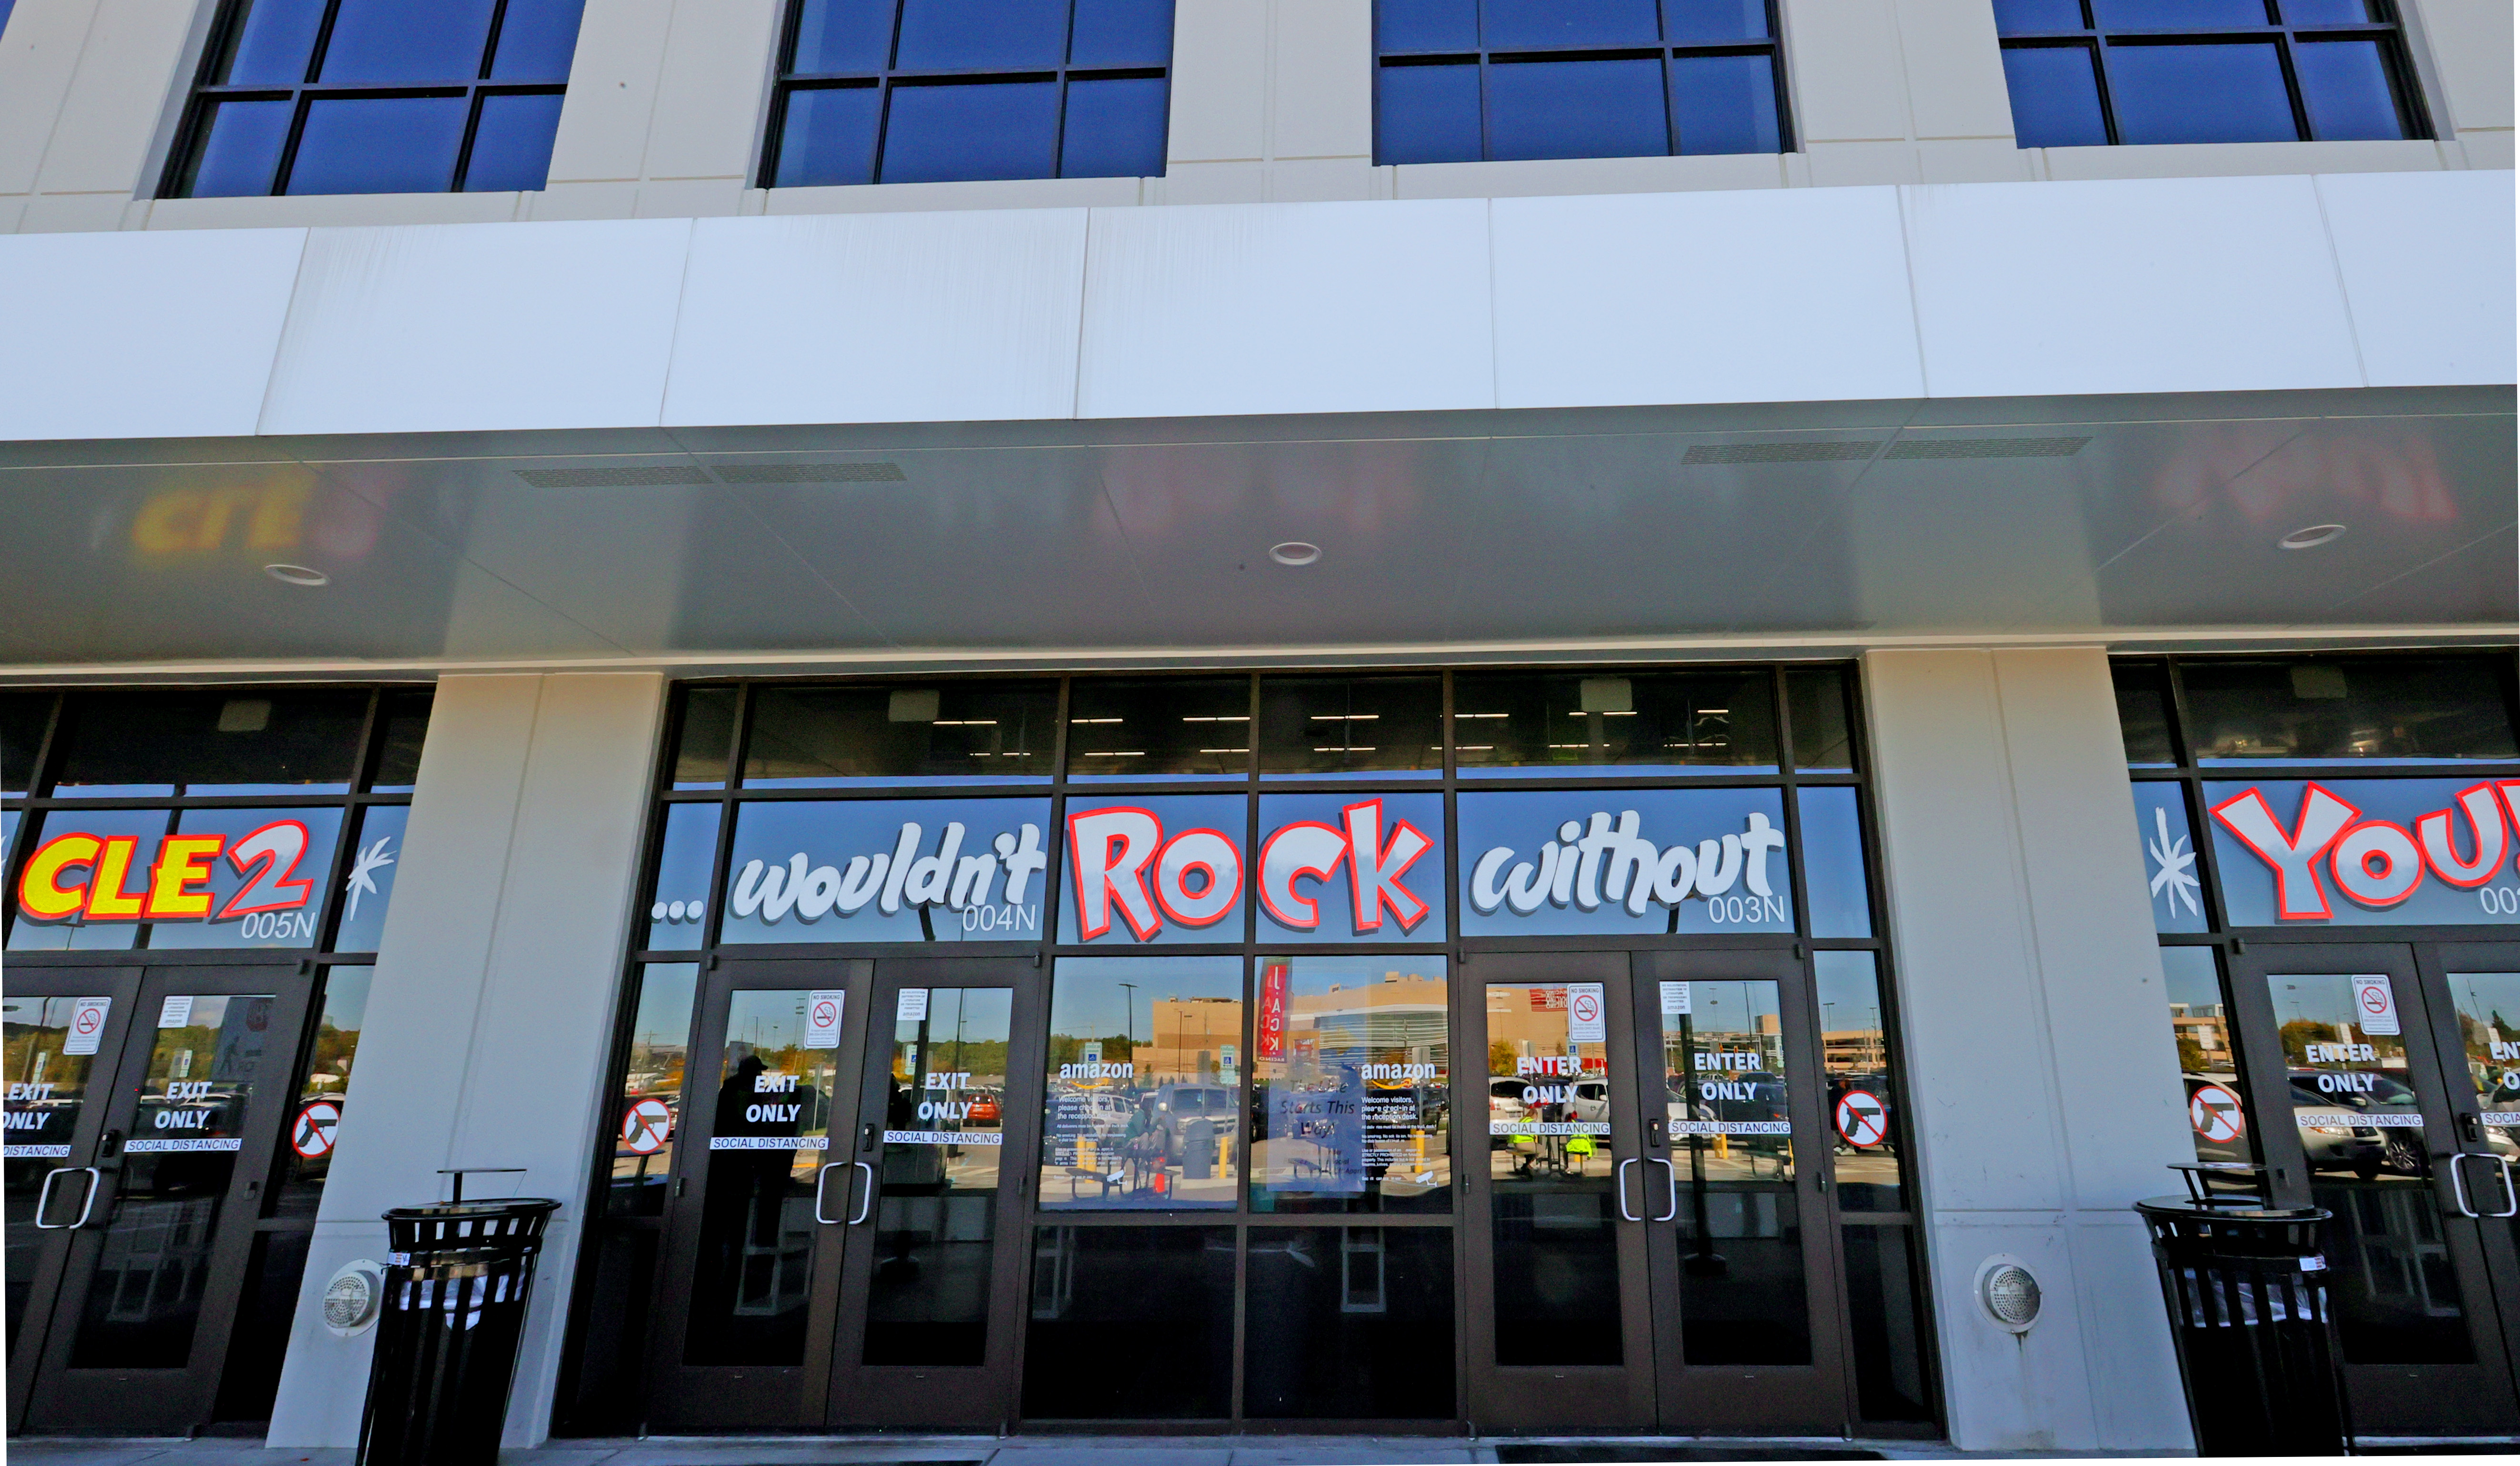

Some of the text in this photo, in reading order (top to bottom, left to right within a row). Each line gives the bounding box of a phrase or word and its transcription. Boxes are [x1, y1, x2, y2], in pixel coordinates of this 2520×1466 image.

[733, 822, 1047, 921] wouldn't
[1472, 810, 1785, 914] without
[1708, 896, 1785, 923] 003N
[2480, 887, 2520, 914] 00
[240, 912, 316, 939] 005N
[962, 904, 1037, 932] 004N
[2304, 1044, 2376, 1063] ENTER
[2489, 1041, 2520, 1060] EN
[1060, 1063, 1133, 1079] amazon
[1361, 1063, 1435, 1079] amazon
[1517, 1056, 1582, 1074] ENTER
[1694, 1053, 1761, 1071] ENTER
[753, 1075, 800, 1093] EXIT
[925, 1072, 971, 1090] EXIT
[2318, 1074, 2374, 1093] ONLY
[7, 1083, 54, 1100] EXIT
[167, 1082, 213, 1099] EXIT
[1522, 1085, 1579, 1104] ONLY
[1701, 1082, 1757, 1100] ONLY
[746, 1104, 801, 1123] ONLY
[917, 1102, 973, 1120] ONLY
[1057, 1104, 1078, 1113] please
[1280, 1100, 1354, 1115] Starts This
[155, 1110, 211, 1129] ONLY
[1671, 1122, 1790, 1133] SOCIAL DISTANCING
[2300, 1114, 2422, 1126] SOCIAL DISTANCING
[887, 1131, 1000, 1144] SOCIAL DISTANCING
[1493, 1124, 1609, 1134] SOCIAL DISTANCING
[4, 1145, 69, 1156] DISTANCING
[128, 1139, 240, 1151] SOCIAL DISTANCING
[713, 1137, 827, 1149] SOCIAL DISTANCING
